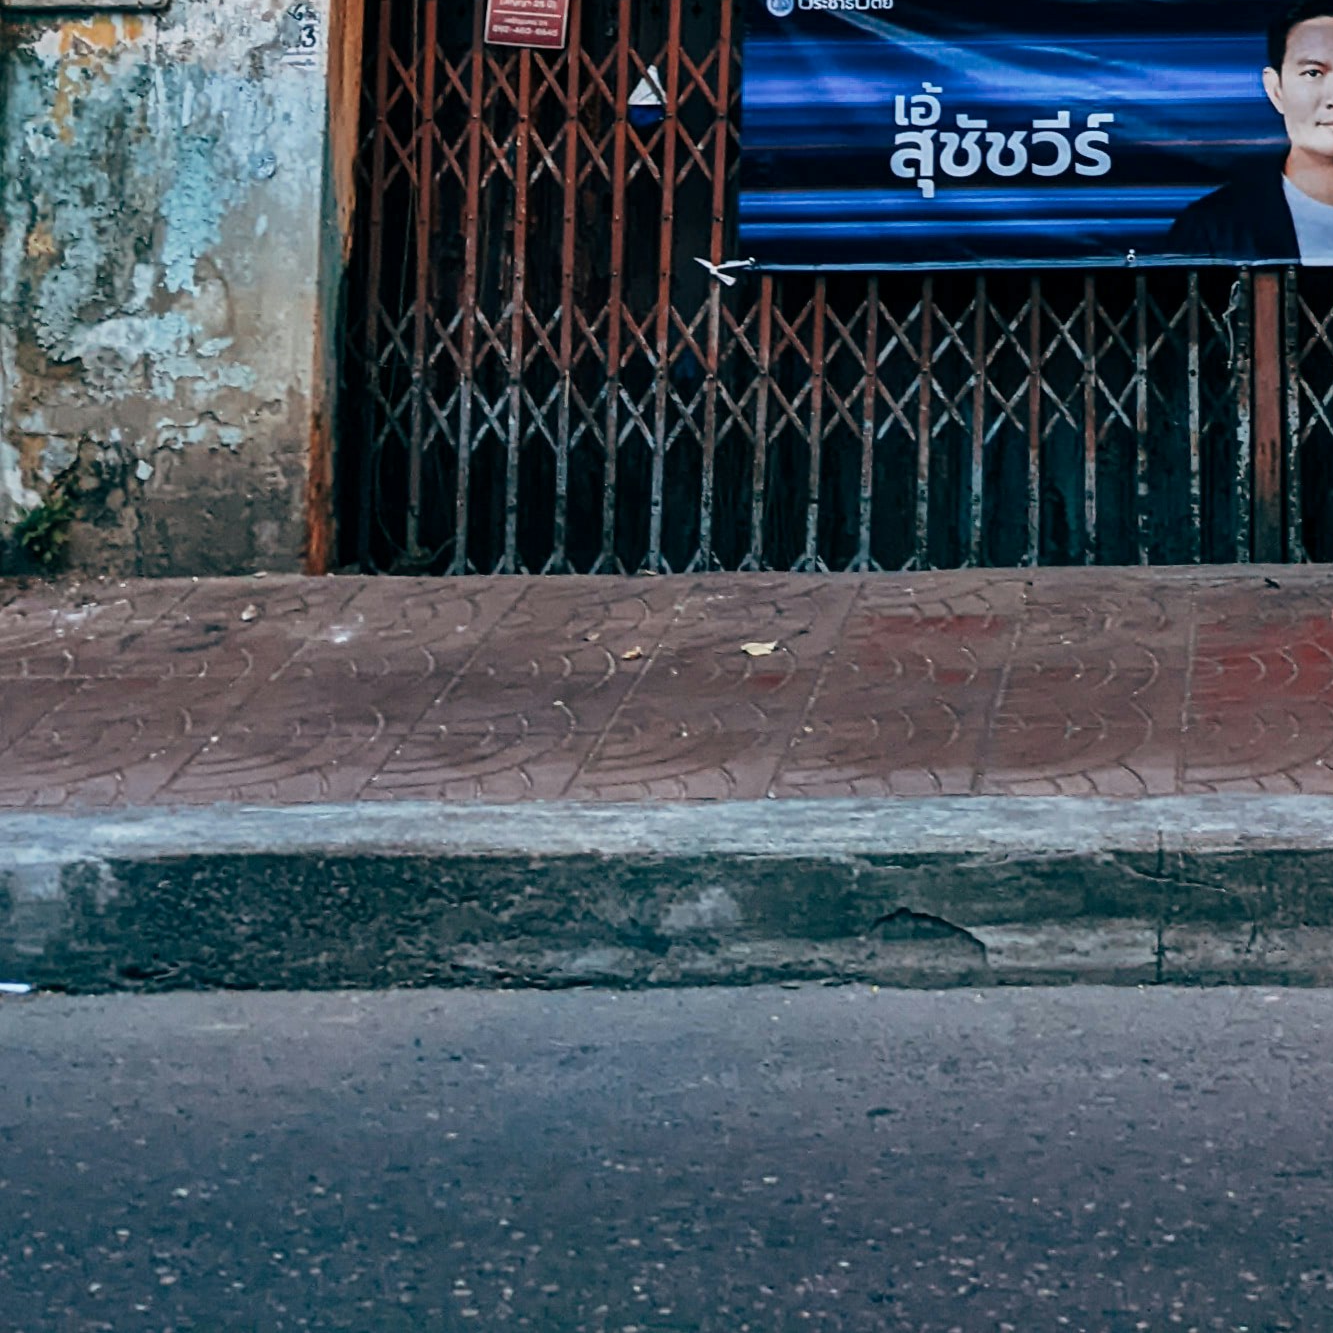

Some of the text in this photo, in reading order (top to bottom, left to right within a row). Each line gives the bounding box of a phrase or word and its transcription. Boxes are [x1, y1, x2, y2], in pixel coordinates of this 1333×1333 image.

[894, 82, 943, 126] เอ้
[890, 111, 1115, 198] สุชัชวีร์
